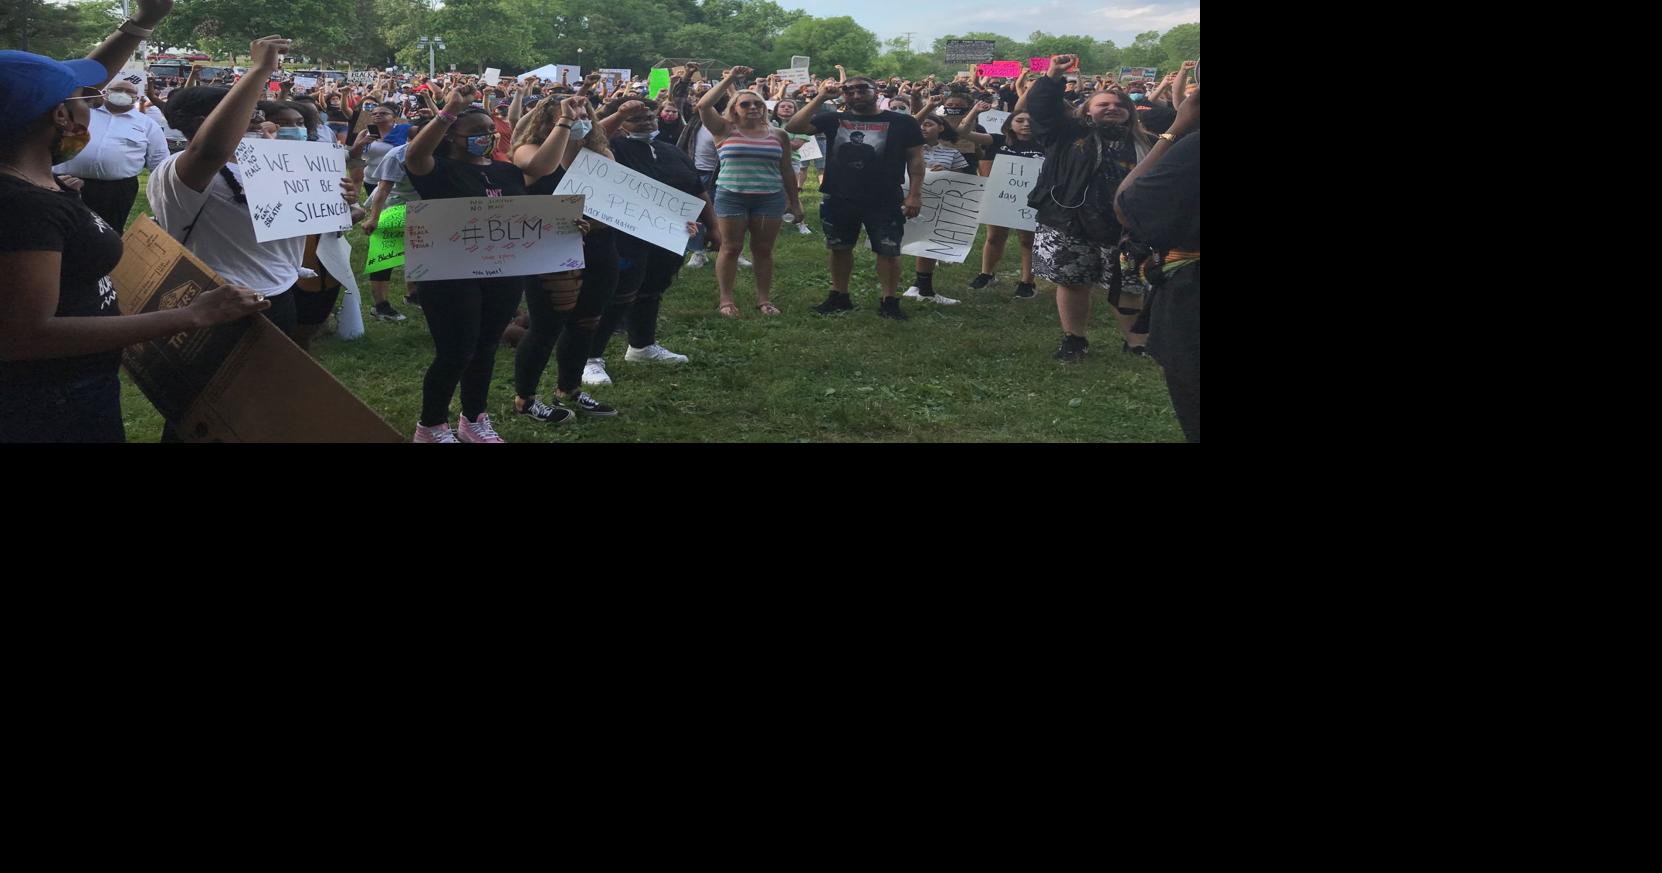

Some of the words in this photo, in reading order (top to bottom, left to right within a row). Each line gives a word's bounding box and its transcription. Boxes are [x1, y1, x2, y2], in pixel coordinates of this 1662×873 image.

[263, 153, 294, 172] WE
[304, 154, 341, 173] WILL
[283, 179, 310, 195] NOT
[319, 180, 334, 193] BE
[578, 154, 608, 178] NO
[613, 170, 698, 217] JUSTICE
[1008, 178, 1030, 188] our
[998, 190, 1017, 203] day
[294, 202, 349, 223] SILENCED
[608, 193, 684, 237] PEACE
[461, 217, 542, 244] #BLM
